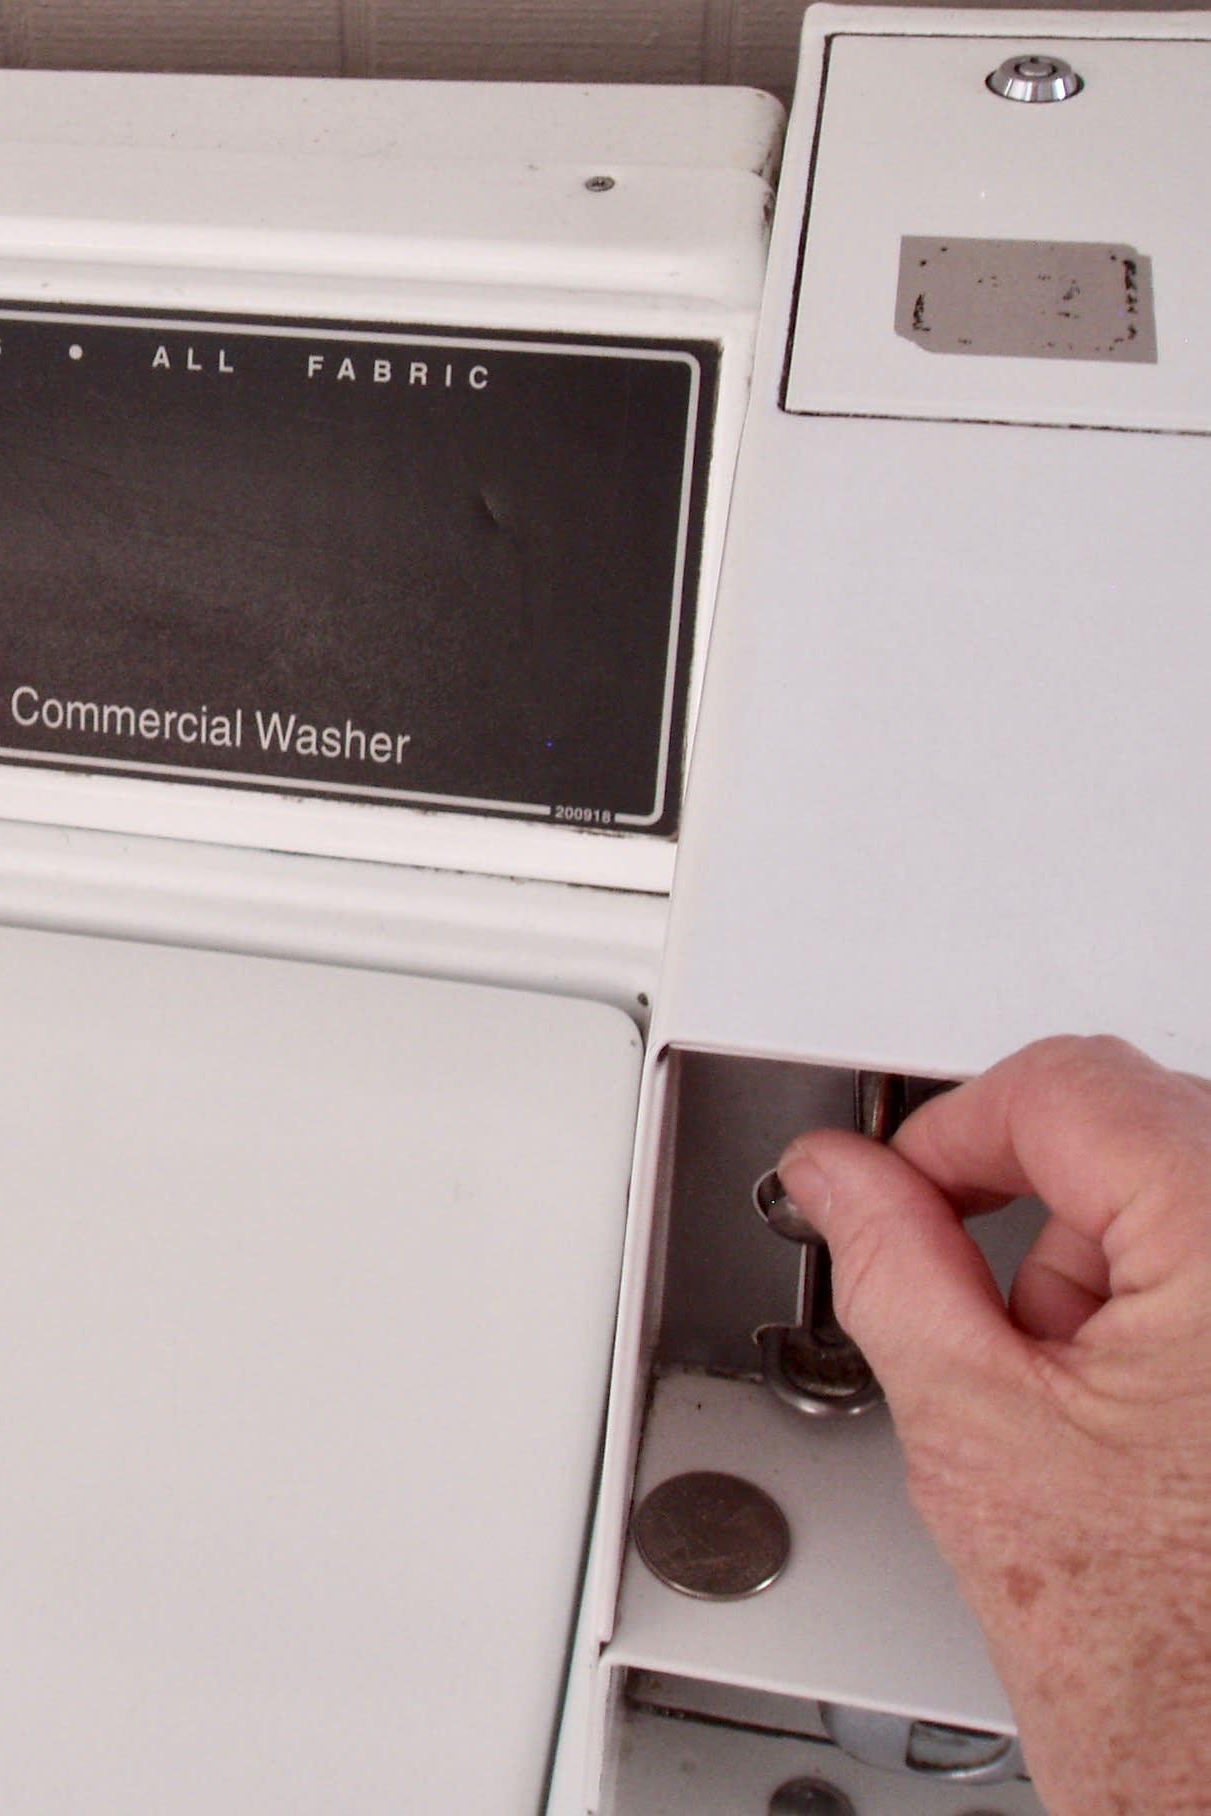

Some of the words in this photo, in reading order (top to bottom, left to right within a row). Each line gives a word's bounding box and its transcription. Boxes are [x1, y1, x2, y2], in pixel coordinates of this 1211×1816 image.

[151, 345, 235, 373] ALL
[307, 355, 489, 391] FABRIC
[10, 685, 243, 748] Commercial
[255, 709, 411, 765] Washer
[554, 804, 612, 825] 200918
